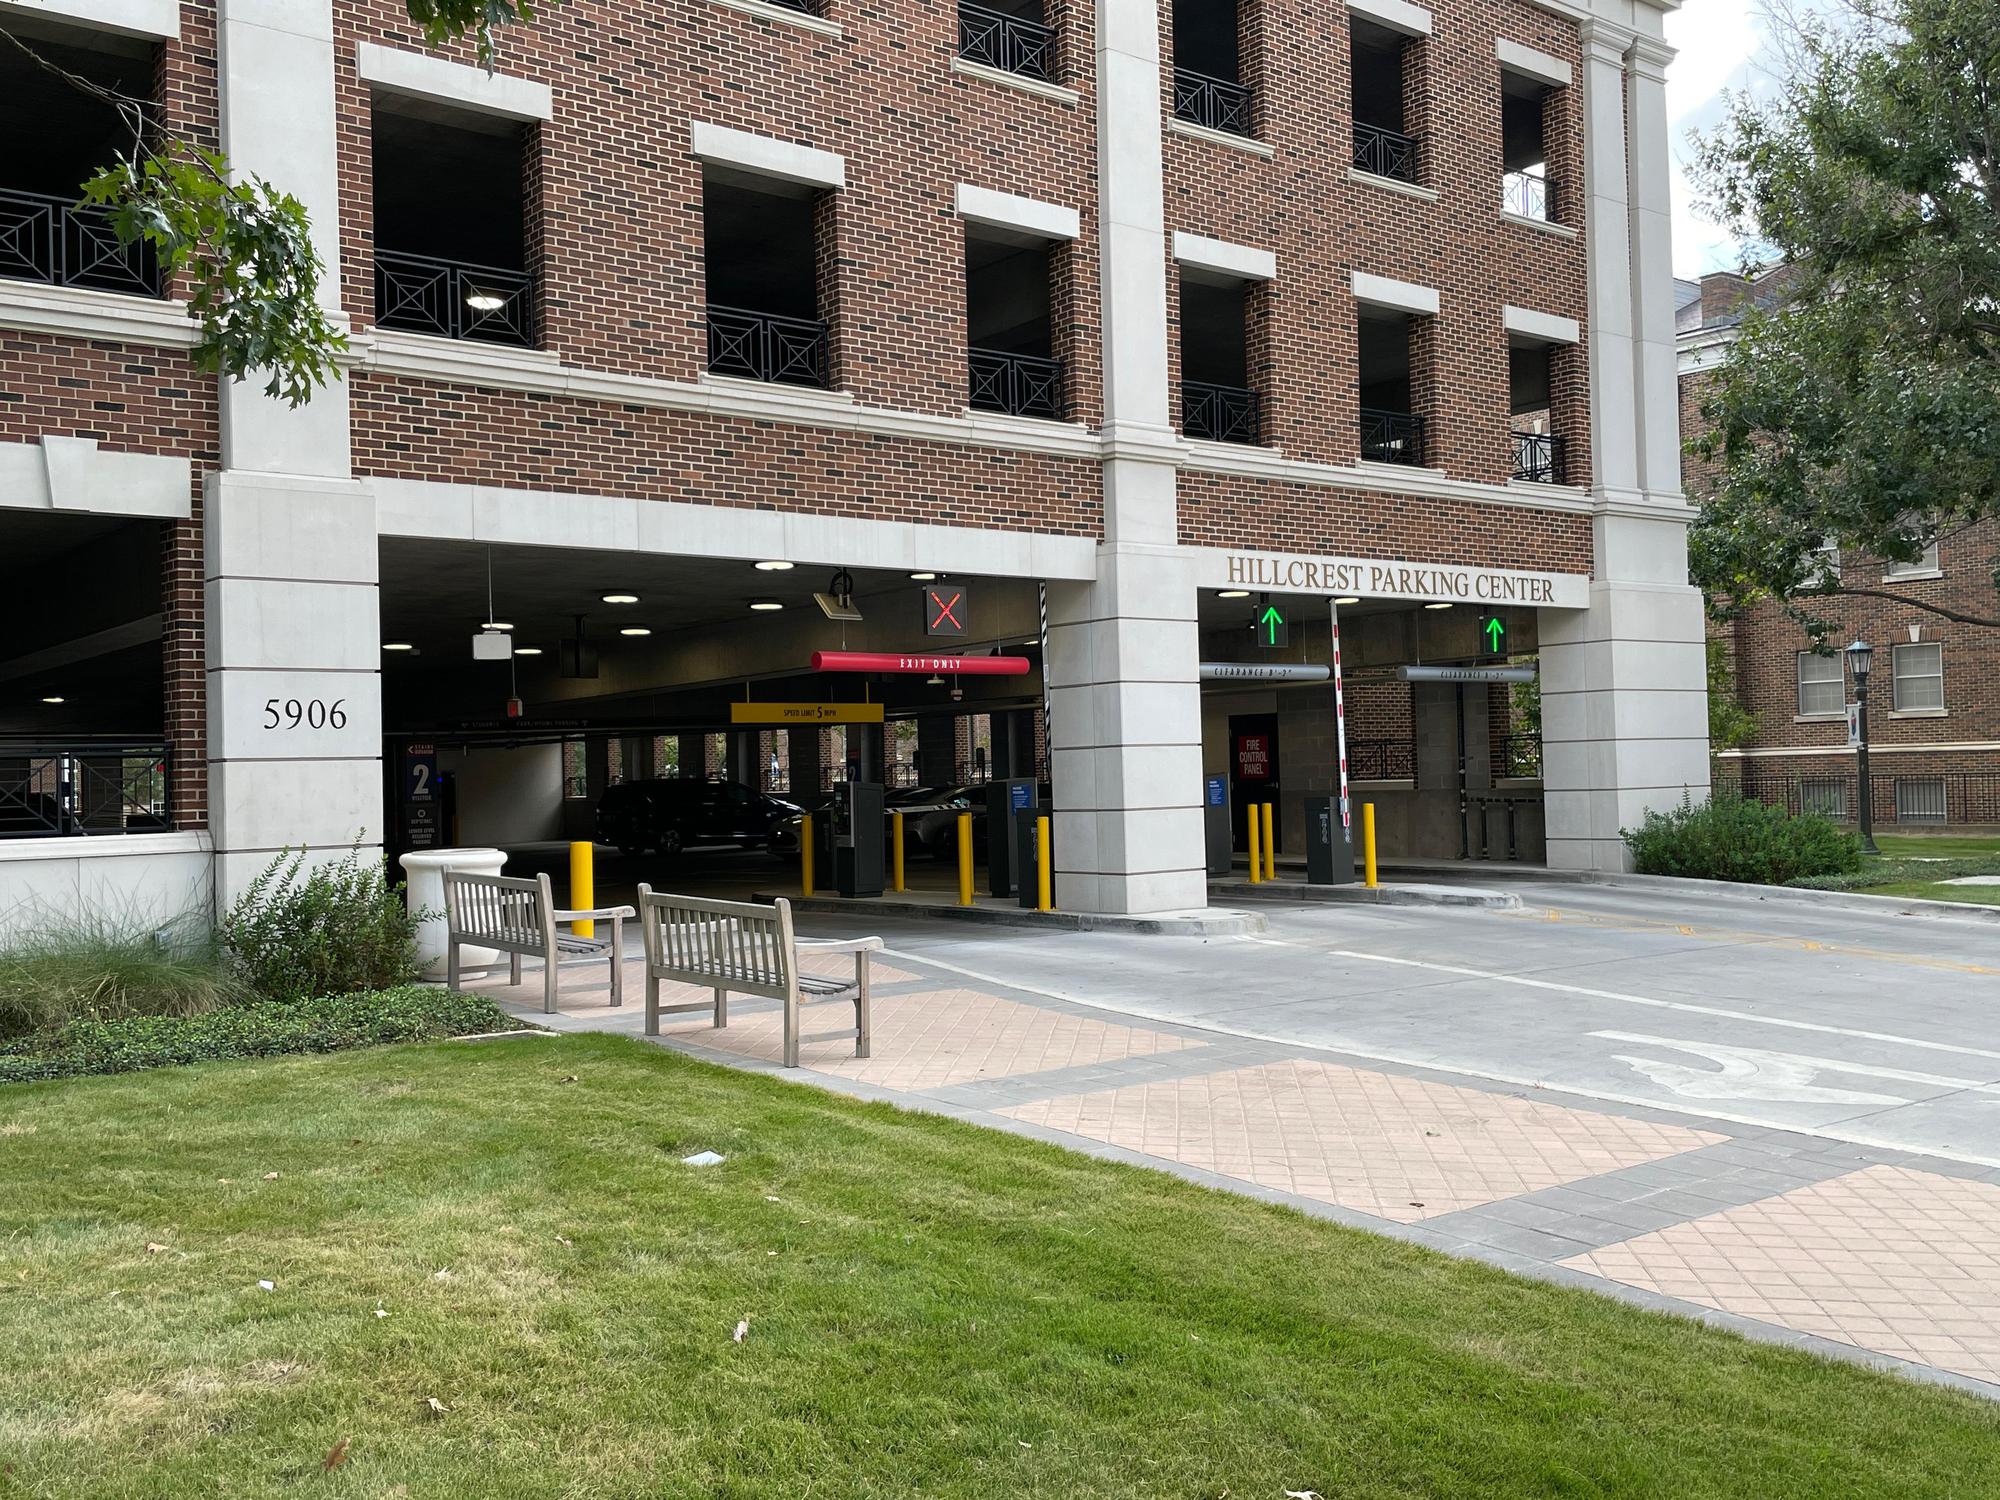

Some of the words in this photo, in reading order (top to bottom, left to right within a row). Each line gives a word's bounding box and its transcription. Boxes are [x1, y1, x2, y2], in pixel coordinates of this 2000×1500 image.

[1227, 556, 1363, 591] HILLCREST
[1371, 566, 1470, 597] PARKING
[1476, 574, 1556, 603] CENTER
[900, 658, 926, 669] EXIT
[933, 658, 961, 669] ONLY
[1214, 667, 1264, 677] CLEARANCE
[263, 699, 347, 730] 5906
[783, 709, 800, 717] SPEED
[801, 709, 815, 717] LIMIT
[817, 705, 823, 719] 5
[824, 709, 837, 717] MPH
[1246, 739, 1261, 751] FIRE
[1239, 751, 1268, 763] CONTROL
[1244, 763, 1264, 775] PANEL
[412, 764, 430, 795] 2
